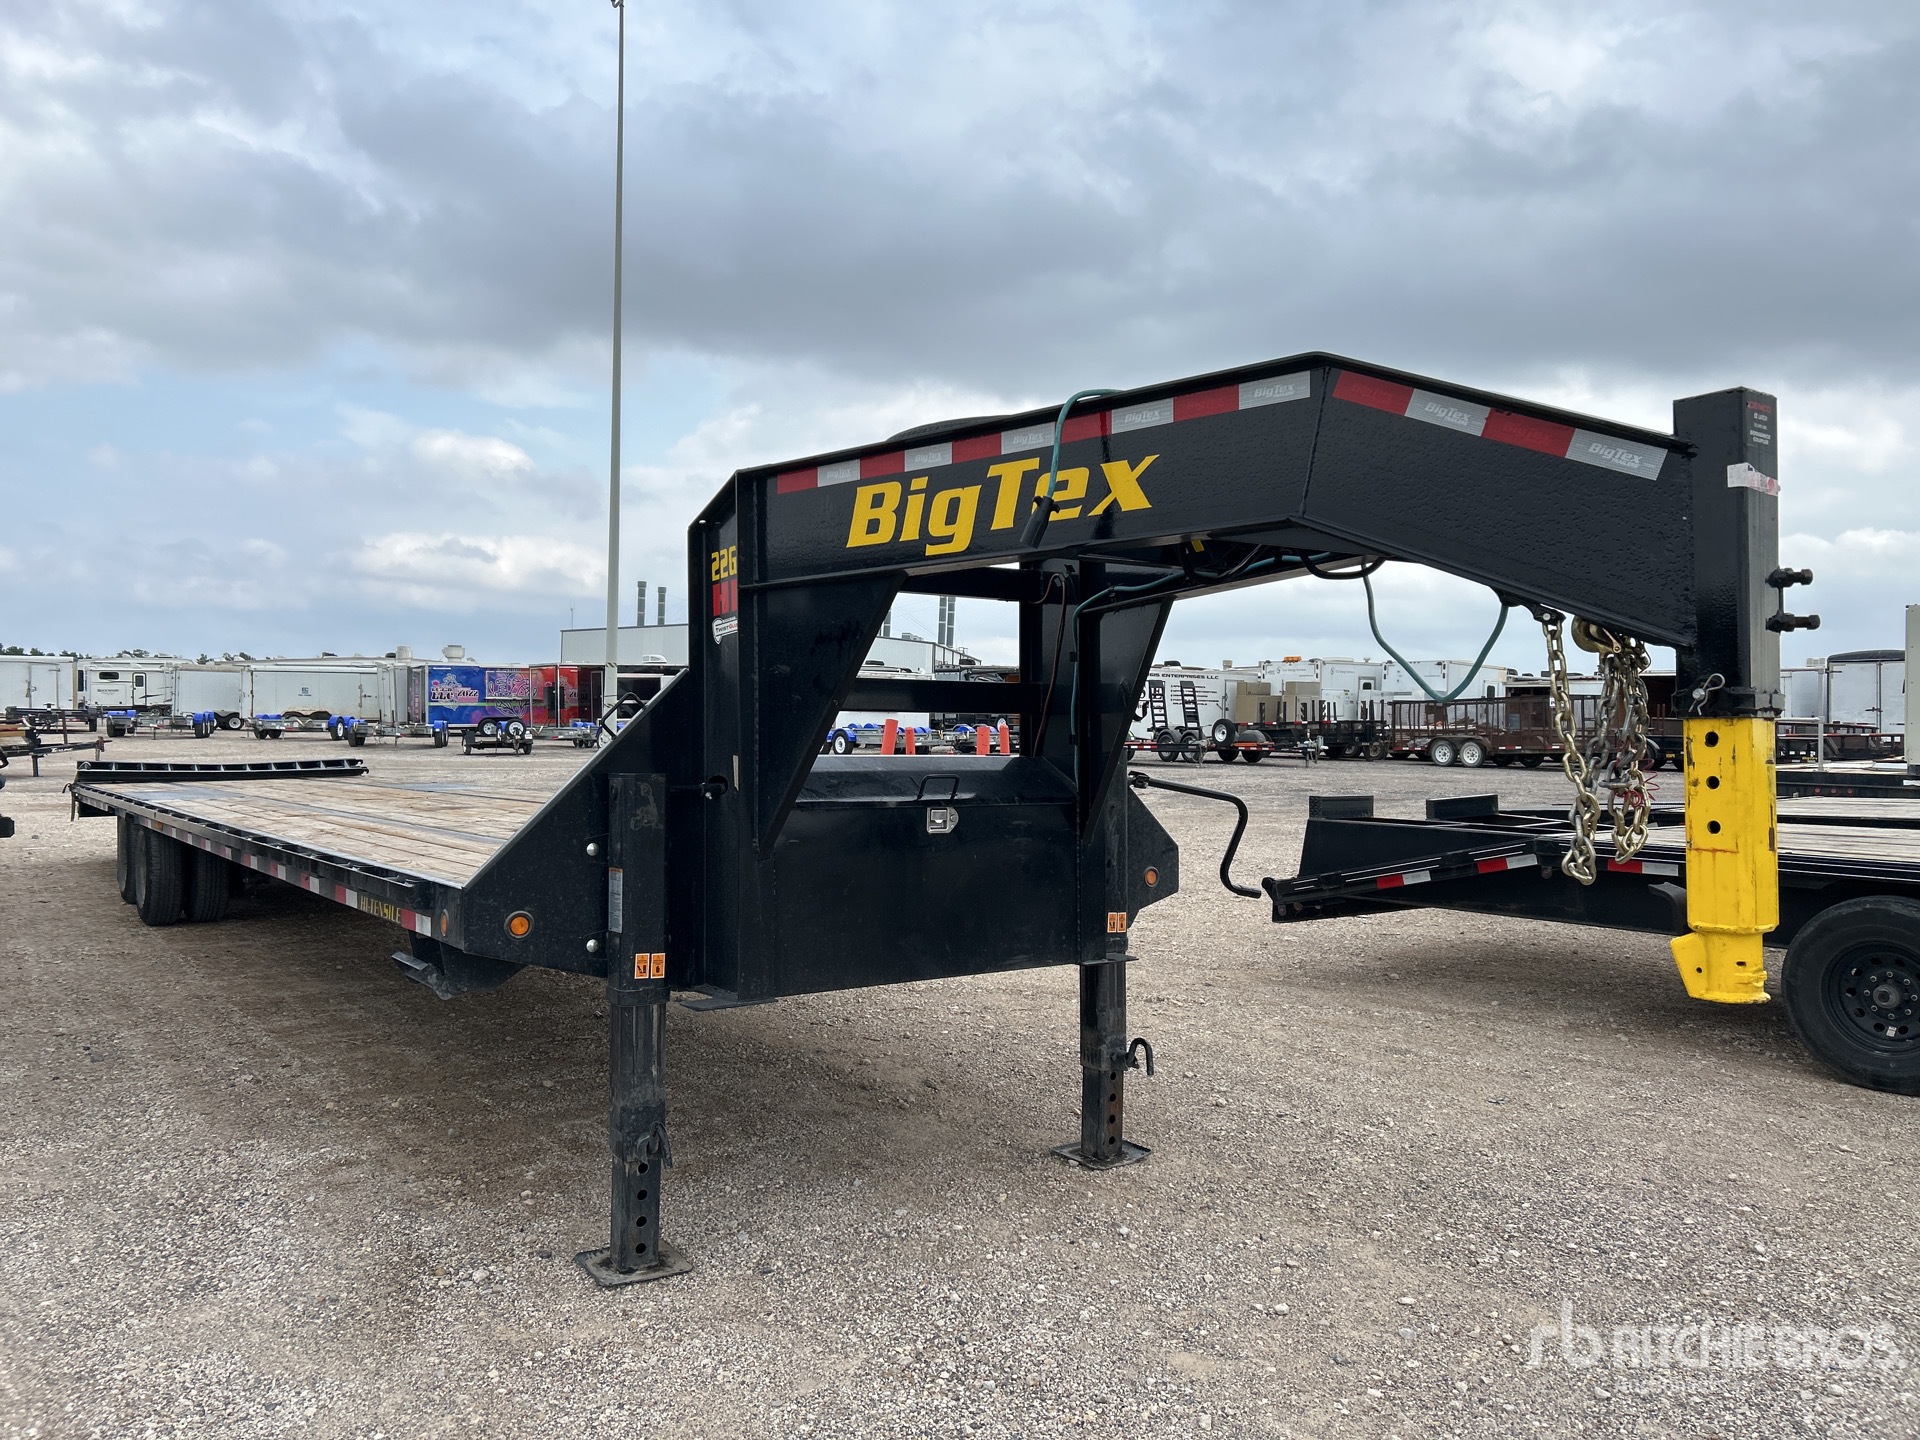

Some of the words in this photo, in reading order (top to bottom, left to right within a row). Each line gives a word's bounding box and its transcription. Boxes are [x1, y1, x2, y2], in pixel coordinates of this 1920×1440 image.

[1254, 384, 1295, 398] BigTex
[1424, 402, 1472, 421] BigTex
[1588, 442, 1643, 464] BigTex
[846, 454, 1160, 556] BigTex
[360, 895, 401, 923] HI-TENSILE
